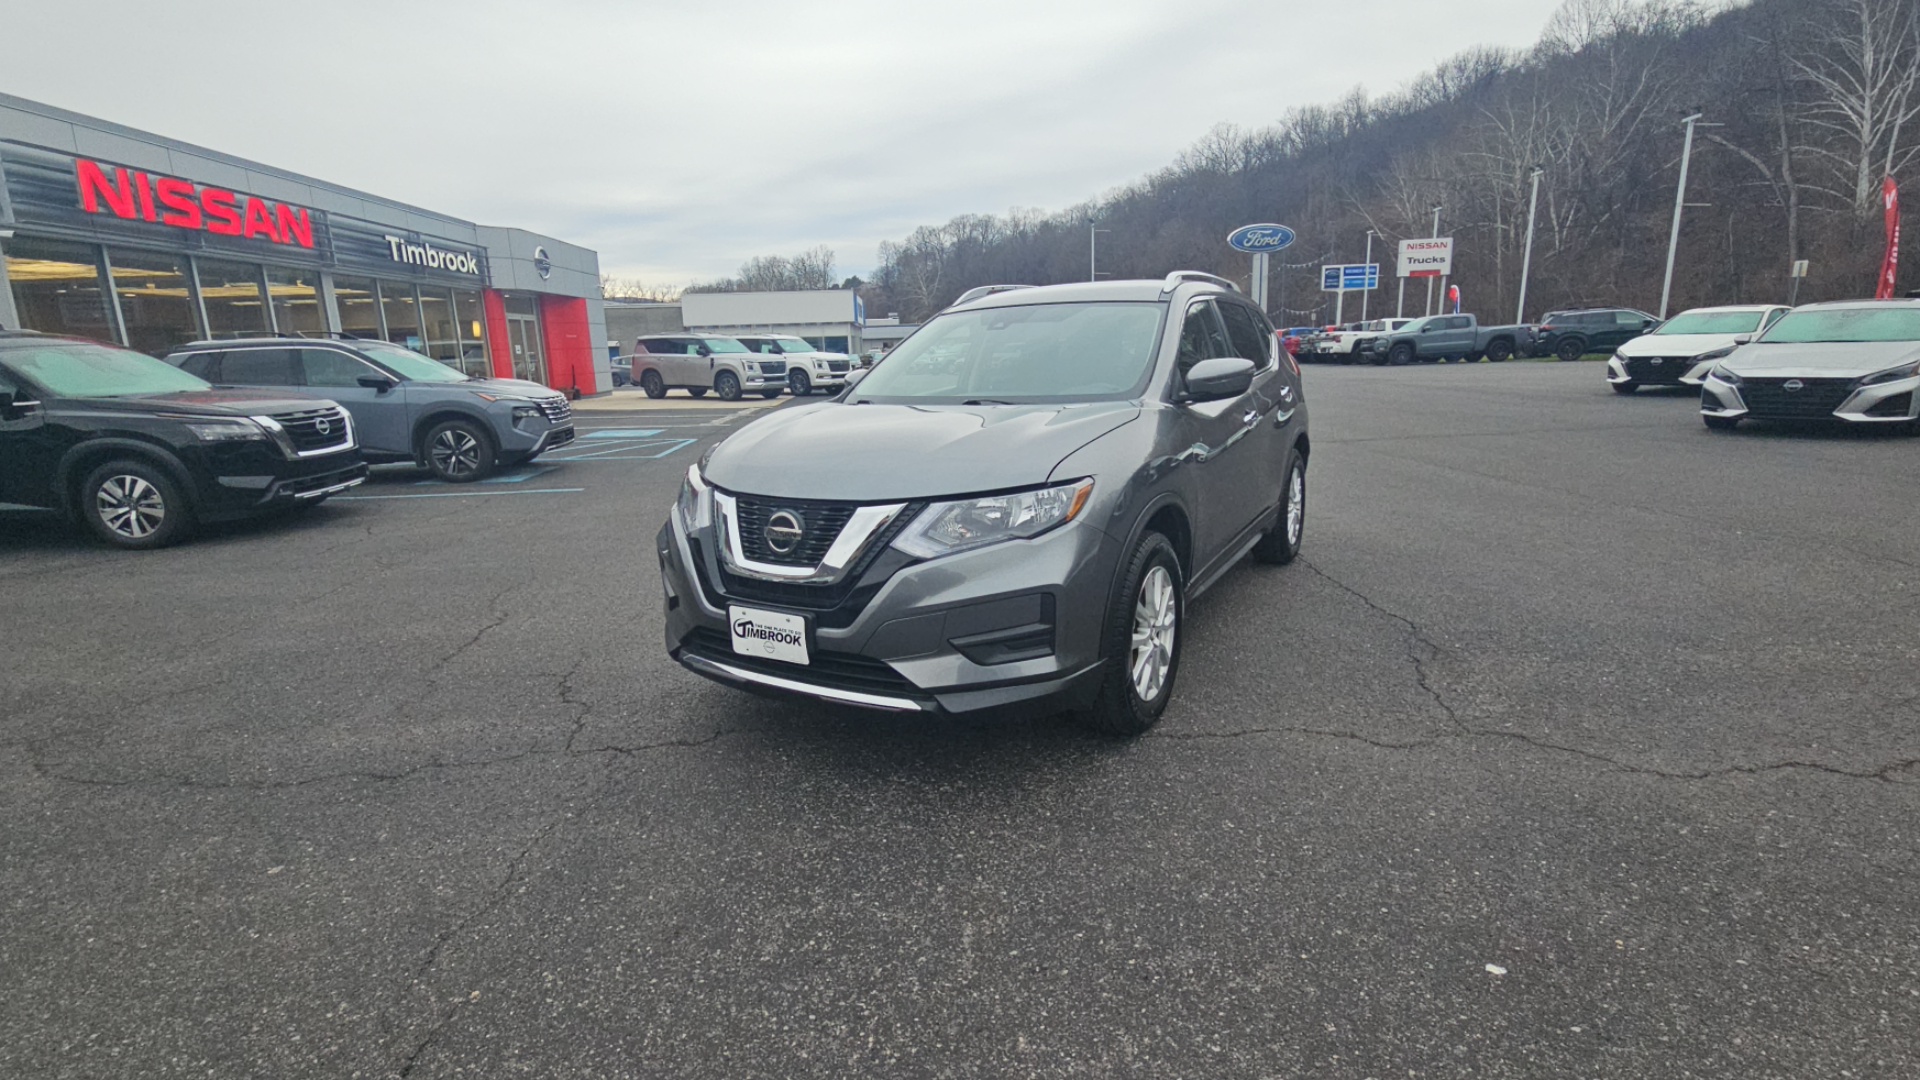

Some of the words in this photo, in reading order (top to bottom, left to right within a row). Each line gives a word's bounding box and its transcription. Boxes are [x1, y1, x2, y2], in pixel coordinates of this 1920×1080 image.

[75, 158, 314, 248] NISSAN
[1243, 229, 1282, 247] Ford
[1407, 241, 1448, 250] NISSAN
[384, 234, 479, 275] Timbrook
[1407, 256, 1446, 264] Trucks
[733, 618, 801, 646] TIMBROOK
